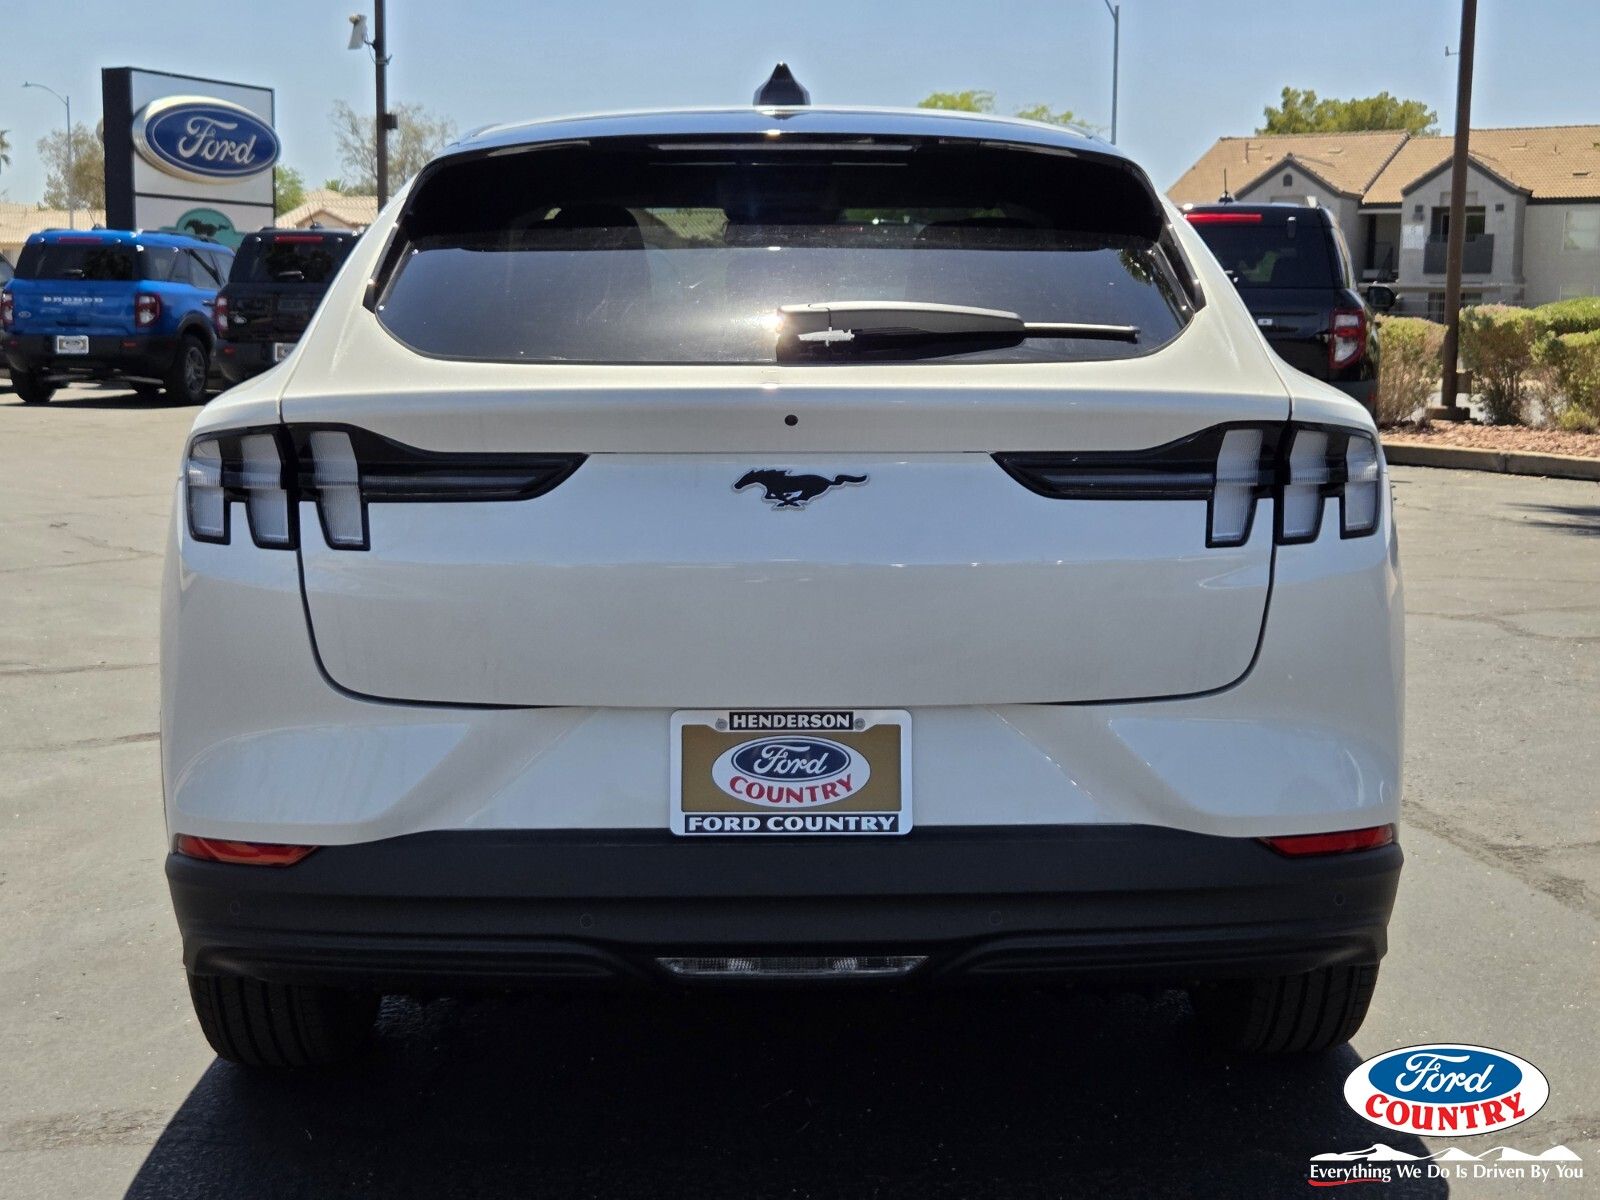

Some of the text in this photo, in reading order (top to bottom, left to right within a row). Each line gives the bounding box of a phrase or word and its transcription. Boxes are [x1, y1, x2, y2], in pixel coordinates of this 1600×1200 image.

[178, 116, 257, 164] Ford
[732, 713, 850, 729] HENDERSON
[753, 744, 829, 775] Ford
[729, 773, 853, 804] COUNTRY
[688, 816, 896, 832] FORD COUNTRY
